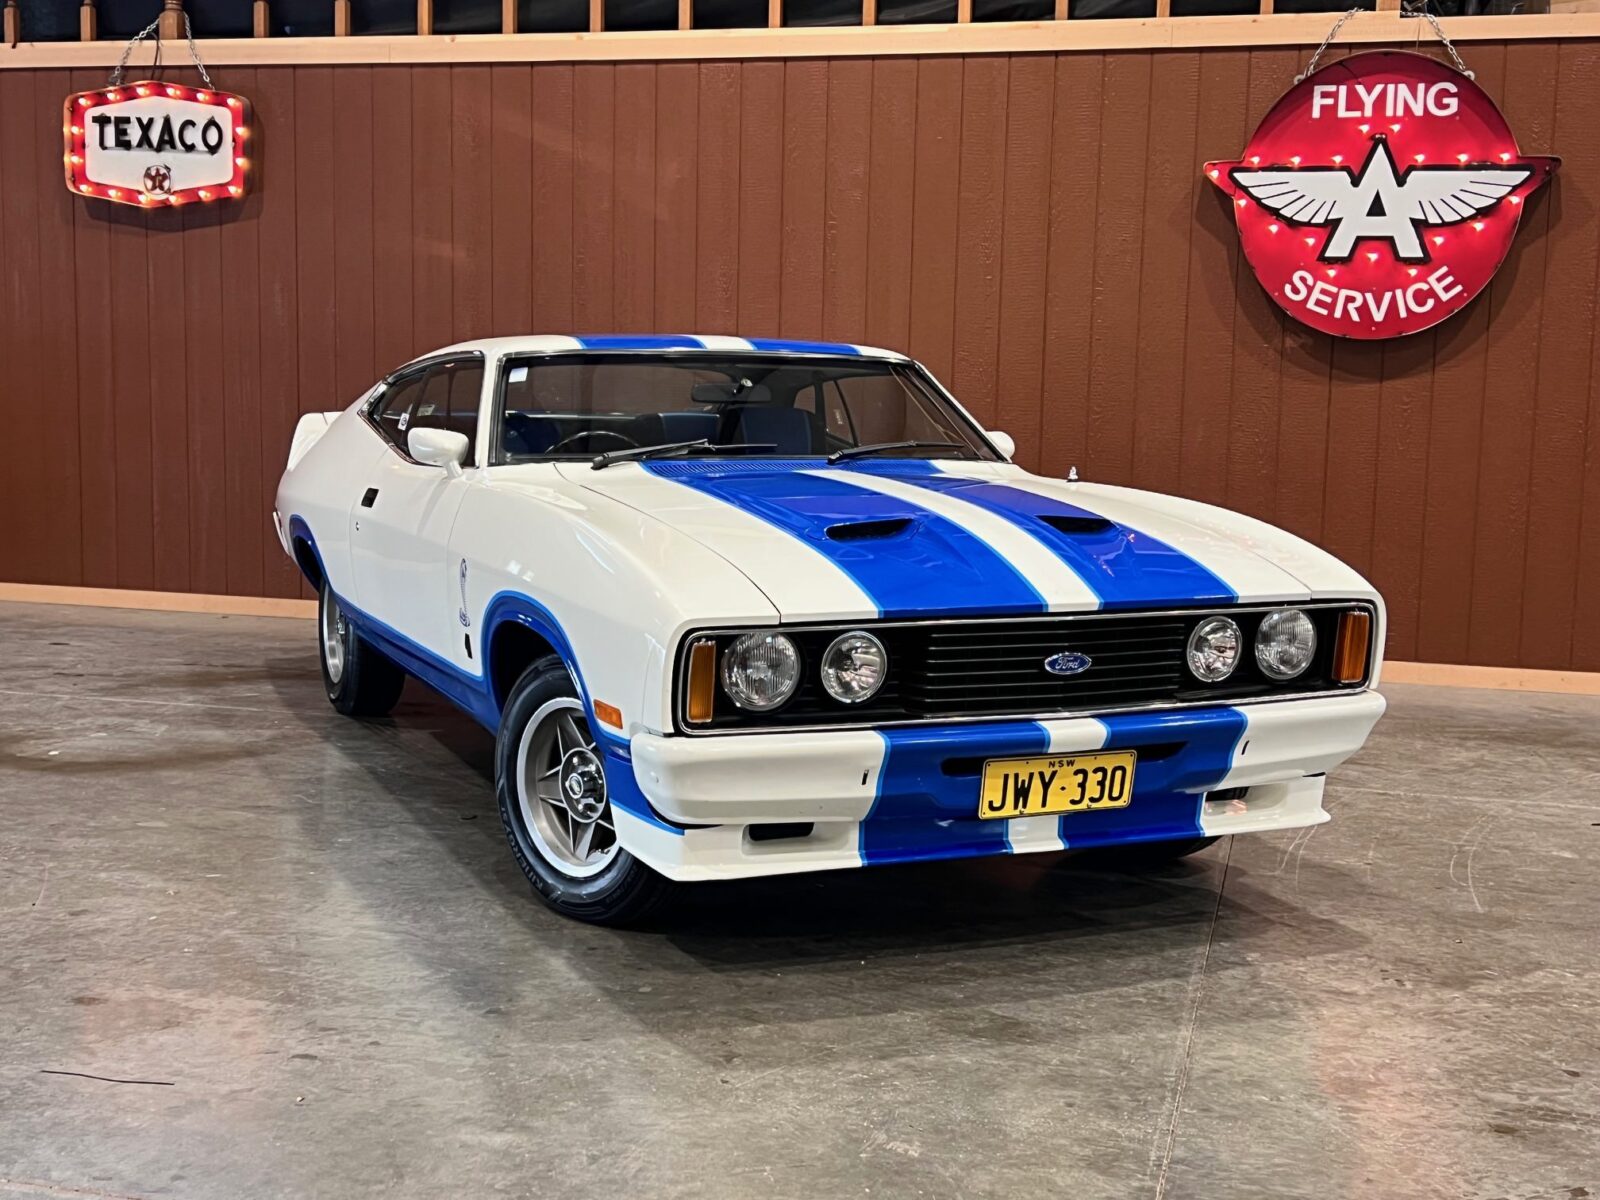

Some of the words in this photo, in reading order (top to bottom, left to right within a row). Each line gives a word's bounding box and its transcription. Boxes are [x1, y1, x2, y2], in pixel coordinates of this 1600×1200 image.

[1311, 82, 1459, 119] FLYING
[92, 114, 224, 156] TEXACO
[1284, 265, 1463, 322] SERVICE
[1055, 656, 1081, 669] Ford
[1048, 759, 1076, 769] NSW
